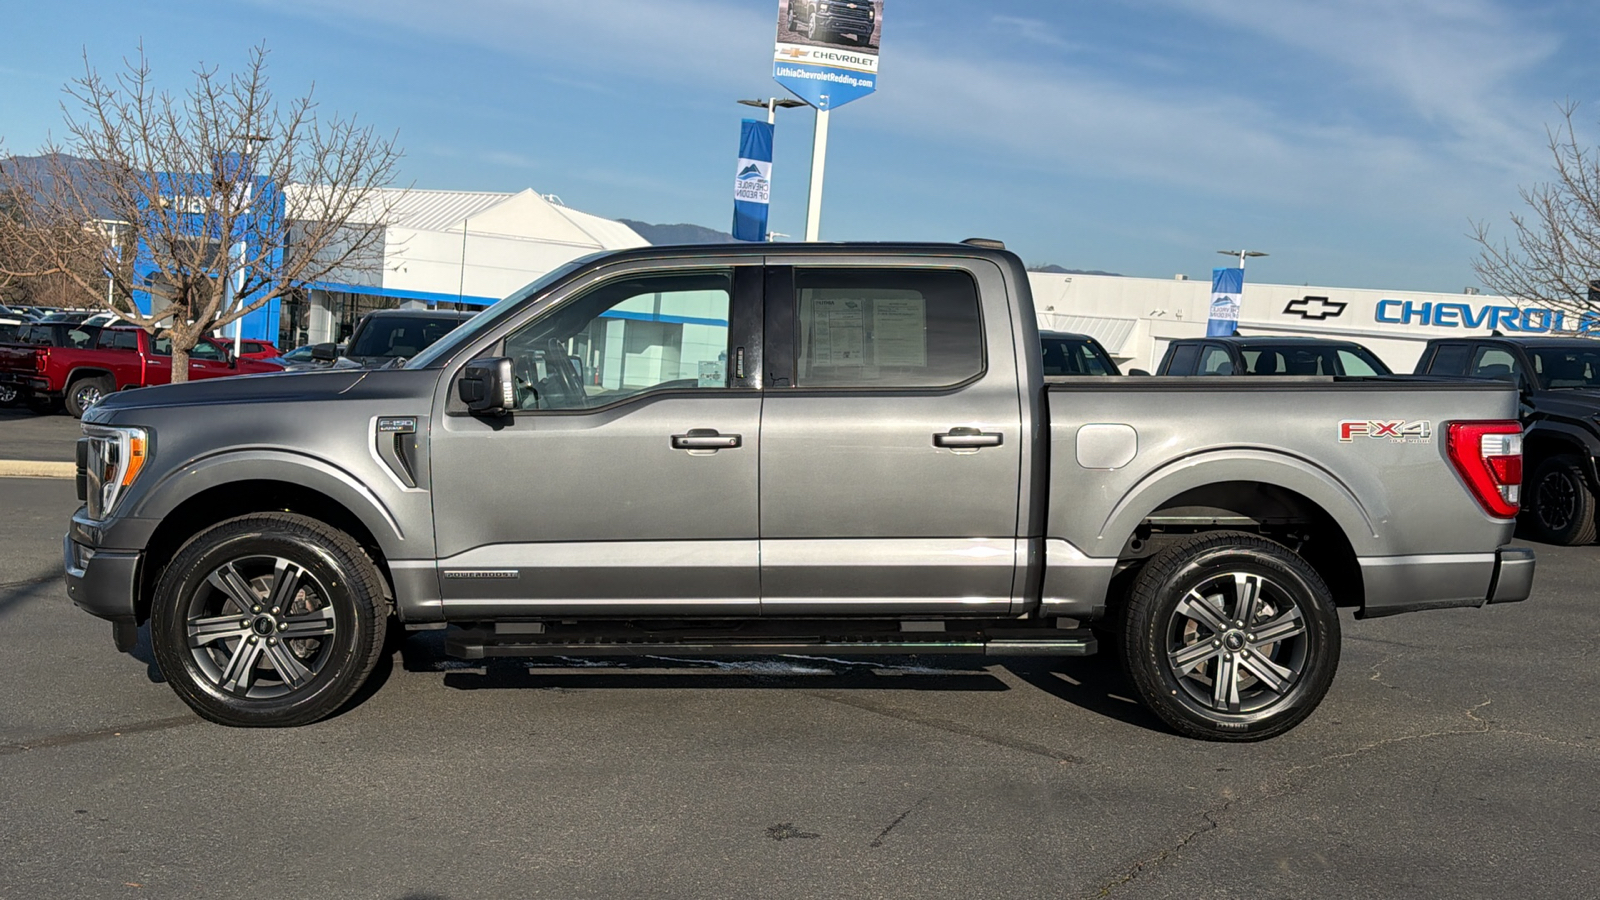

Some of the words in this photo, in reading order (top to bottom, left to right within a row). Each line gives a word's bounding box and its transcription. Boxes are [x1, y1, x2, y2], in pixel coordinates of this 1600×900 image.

[813, 51, 874, 66] CHEVROLET
[777, 67, 873, 87] LithiaChevroletRedding.com
[1338, 420, 1431, 443] FX4
